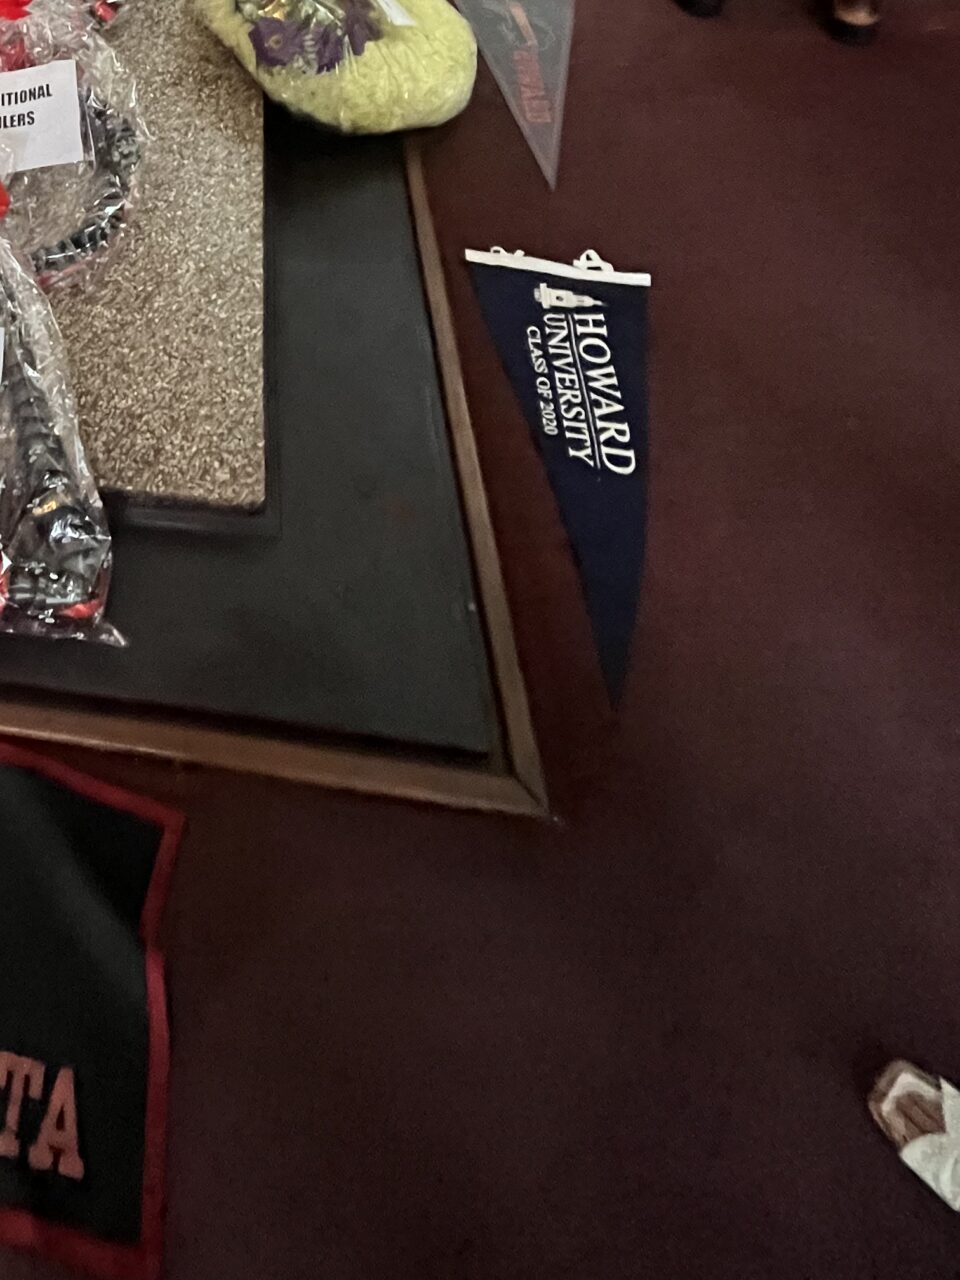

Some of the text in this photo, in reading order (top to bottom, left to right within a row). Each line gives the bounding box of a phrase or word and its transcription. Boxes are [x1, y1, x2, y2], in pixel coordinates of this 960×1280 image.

[526, 325, 558, 435] CLASS OF 2020
[543, 313, 594, 467] UNIVERSITY
[573, 313, 636, 475] HOWARD
